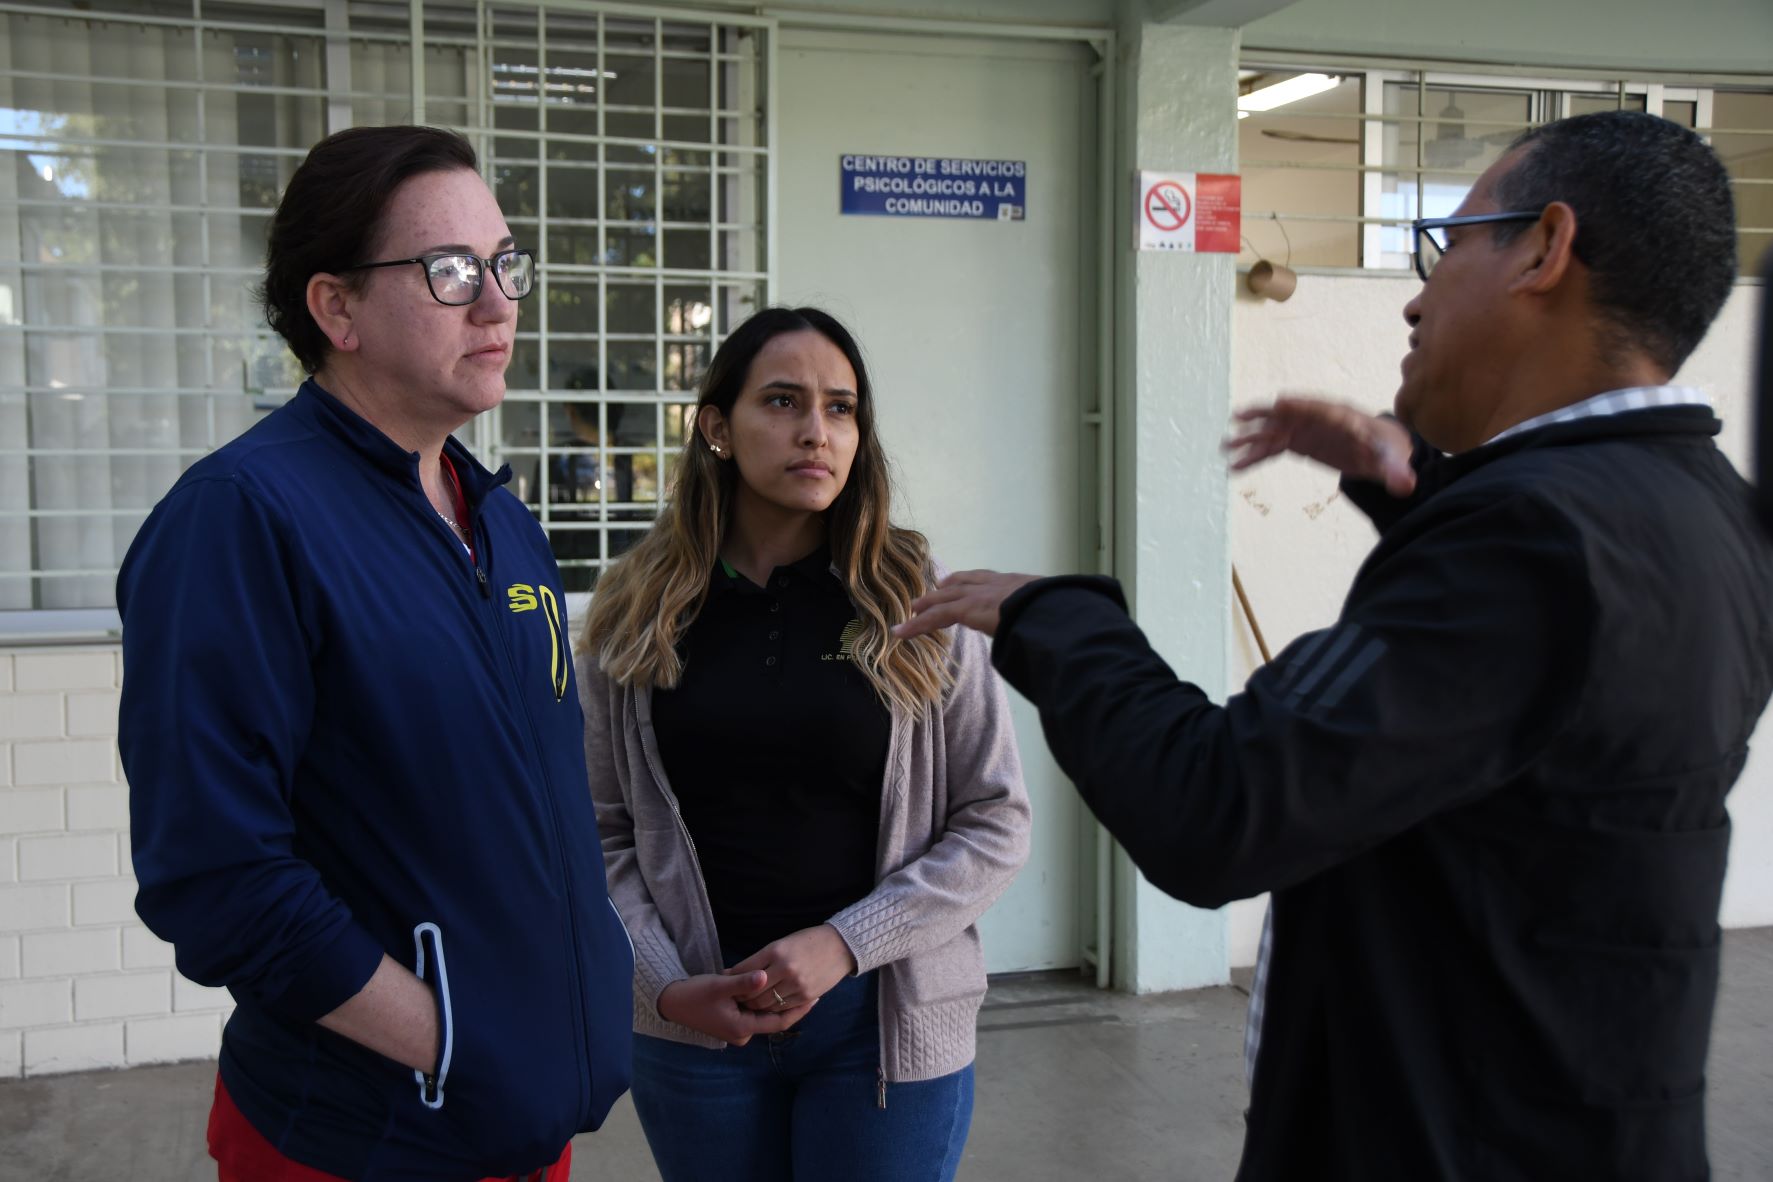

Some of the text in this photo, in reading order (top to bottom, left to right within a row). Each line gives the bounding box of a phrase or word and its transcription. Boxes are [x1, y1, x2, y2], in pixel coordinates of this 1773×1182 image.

[842, 156, 1025, 177] CENTRO DE SERVICIOS
[853, 175, 1015, 196] PSICOLÓGICOS A LA
[885, 198, 984, 216] COMUNIDAD
